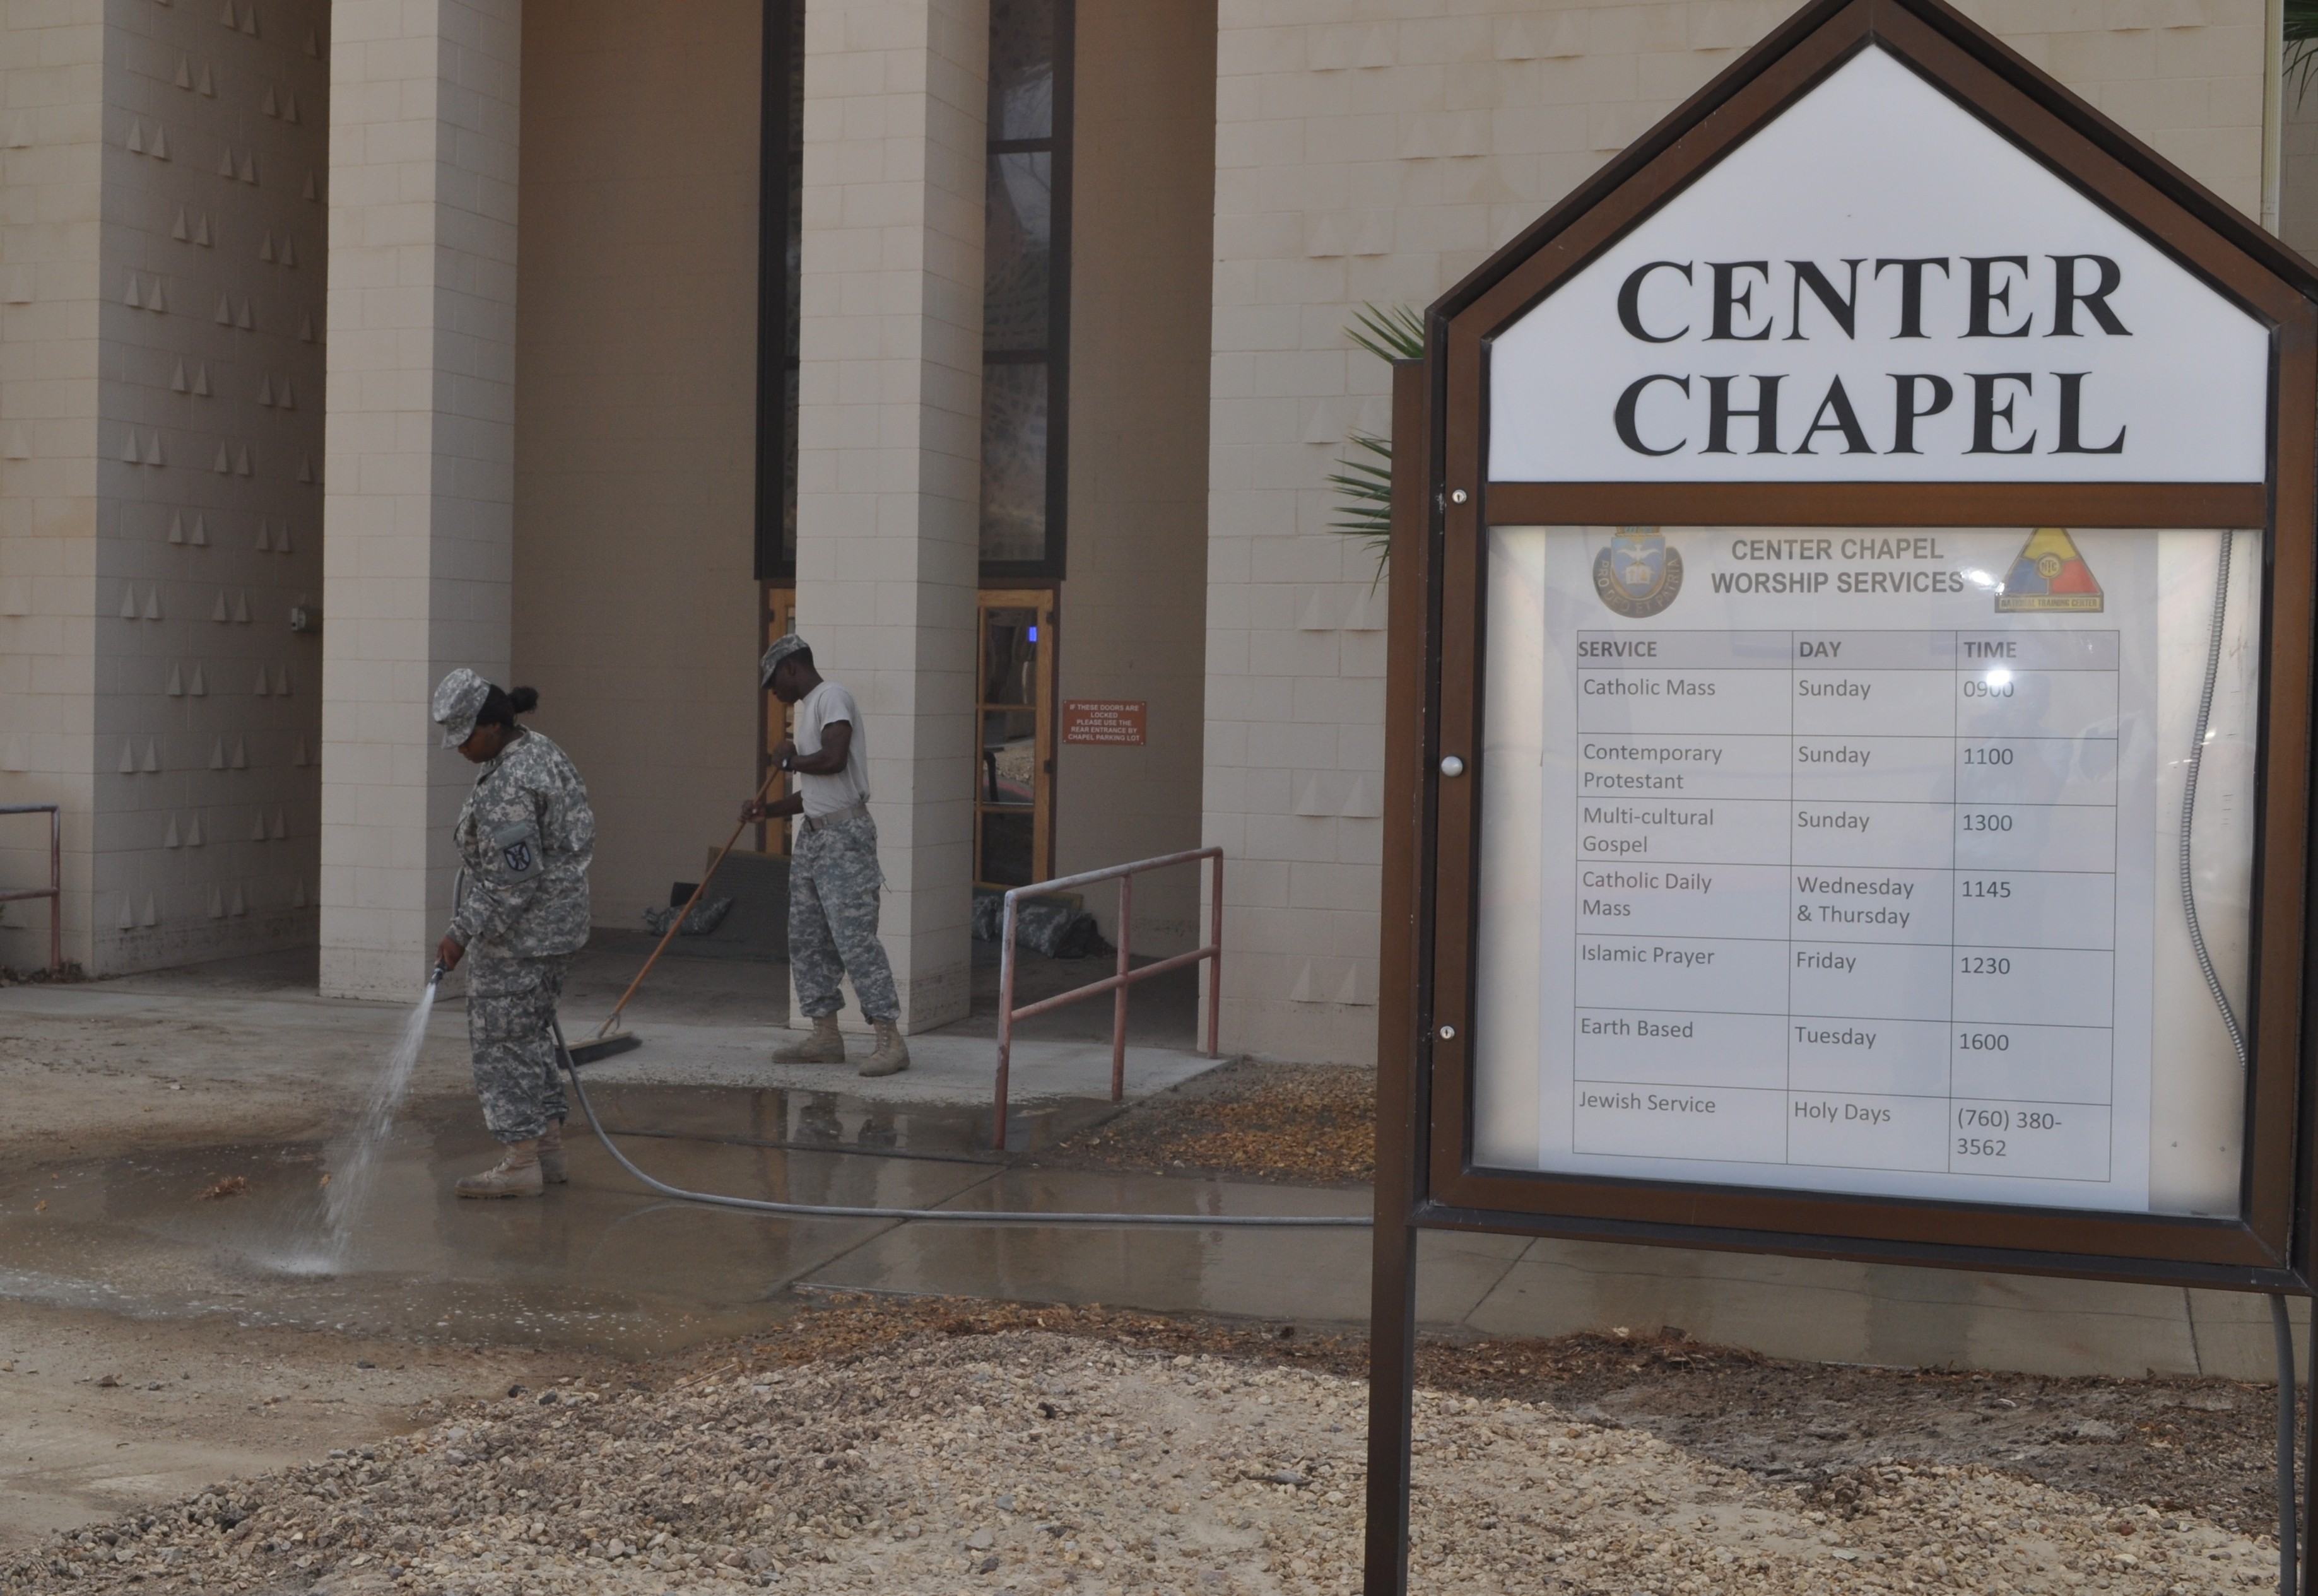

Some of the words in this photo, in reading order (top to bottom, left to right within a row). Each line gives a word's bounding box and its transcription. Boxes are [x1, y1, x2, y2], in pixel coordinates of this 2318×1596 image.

[1617, 254, 2133, 343] CENTER
[1614, 372, 2126, 457] CHAPEL
[1732, 539, 1832, 560] CENTER
[1841, 537, 1944, 560] CHAPEL
[1597, 560, 1609, 587] PRO
[2041, 560, 2057, 573] NTC
[1711, 572, 1828, 594] WORSHIP
[1837, 572, 1964, 593] SERVICES
[1579, 641, 1657, 657] SERVICE
[1799, 642, 1842, 657] DAY
[1963, 642, 2016, 658] TIME
[1584, 678, 1660, 695] Catholic
[1667, 679, 1715, 696] Mass
[1799, 679, 1871, 700] Sunday
[1963, 680, 2015, 698] 0900
[1584, 743, 1722, 765] Contemporary
[1798, 746, 1871, 767] Sunday
[1964, 748, 2013, 765] 1100
[1584, 772, 1684, 789] Protestant
[1584, 807, 1713, 825] Multi-cultural
[1797, 811, 1870, 833] Sunday
[1963, 814, 2013, 831] 1300
[1583, 835, 1647, 856] Gospel
[1583, 871, 1659, 889] Catholic
[1666, 873, 1712, 894] Daily
[1797, 876, 1914, 900] Wednesday
[1963, 881, 2011, 898] 1145
[1583, 899, 1631, 917] Mass
[1797, 905, 1812, 922] &
[1818, 905, 1910, 929] Thursday
[1582, 944, 1647, 963] Islamic
[1654, 947, 1715, 968] Prayer
[1797, 951, 1856, 973] Friday
[1962, 957, 2010, 975] 1230
[1582, 1018, 1630, 1035] Earth
[1638, 1020, 1693, 1038] Based
[1794, 1026, 1876, 1050] Tuesday
[1960, 1033, 2009, 1051] 1600
[1579, 1091, 1641, 1110] Jewish
[1647, 1094, 1715, 1113] Service
[1795, 1101, 1838, 1123] Holy
[1845, 1103, 1891, 1125] Days
[1958, 1108, 2009, 1131] (760)
[2016, 1112, 2062, 1130] 380-
[1957, 1138, 2006, 1156] 3562
